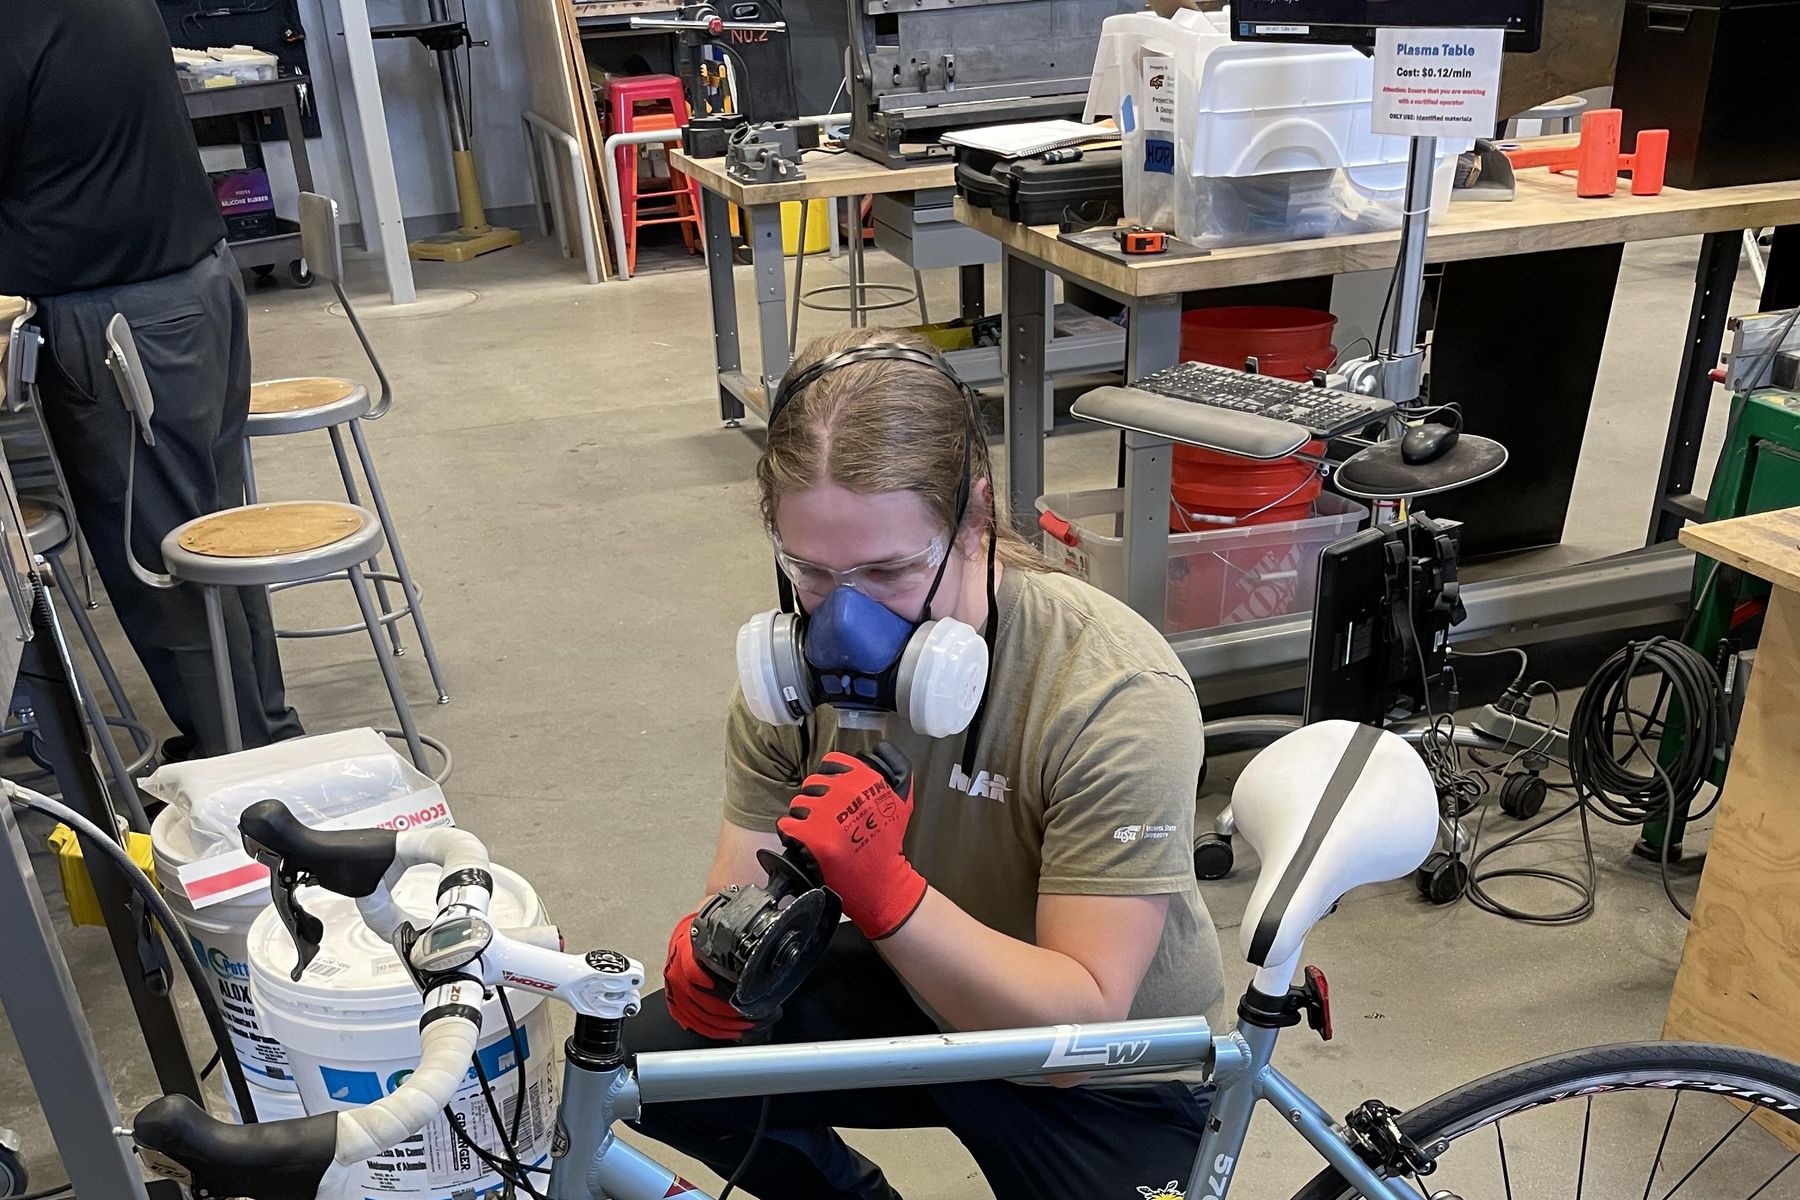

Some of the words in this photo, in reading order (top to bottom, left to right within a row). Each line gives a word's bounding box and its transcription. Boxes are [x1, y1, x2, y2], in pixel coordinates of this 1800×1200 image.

[1397, 43, 1439, 56] Plasma
[1442, 44, 1475, 56] Table
[1396, 67, 1420, 77] Cost:
[1421, 67, 1472, 78] $0.12/min
[1462, 88, 1486, 96] working
[836, 780, 890, 824] DULFIN
[456, 1112, 471, 1171] GRINGER
